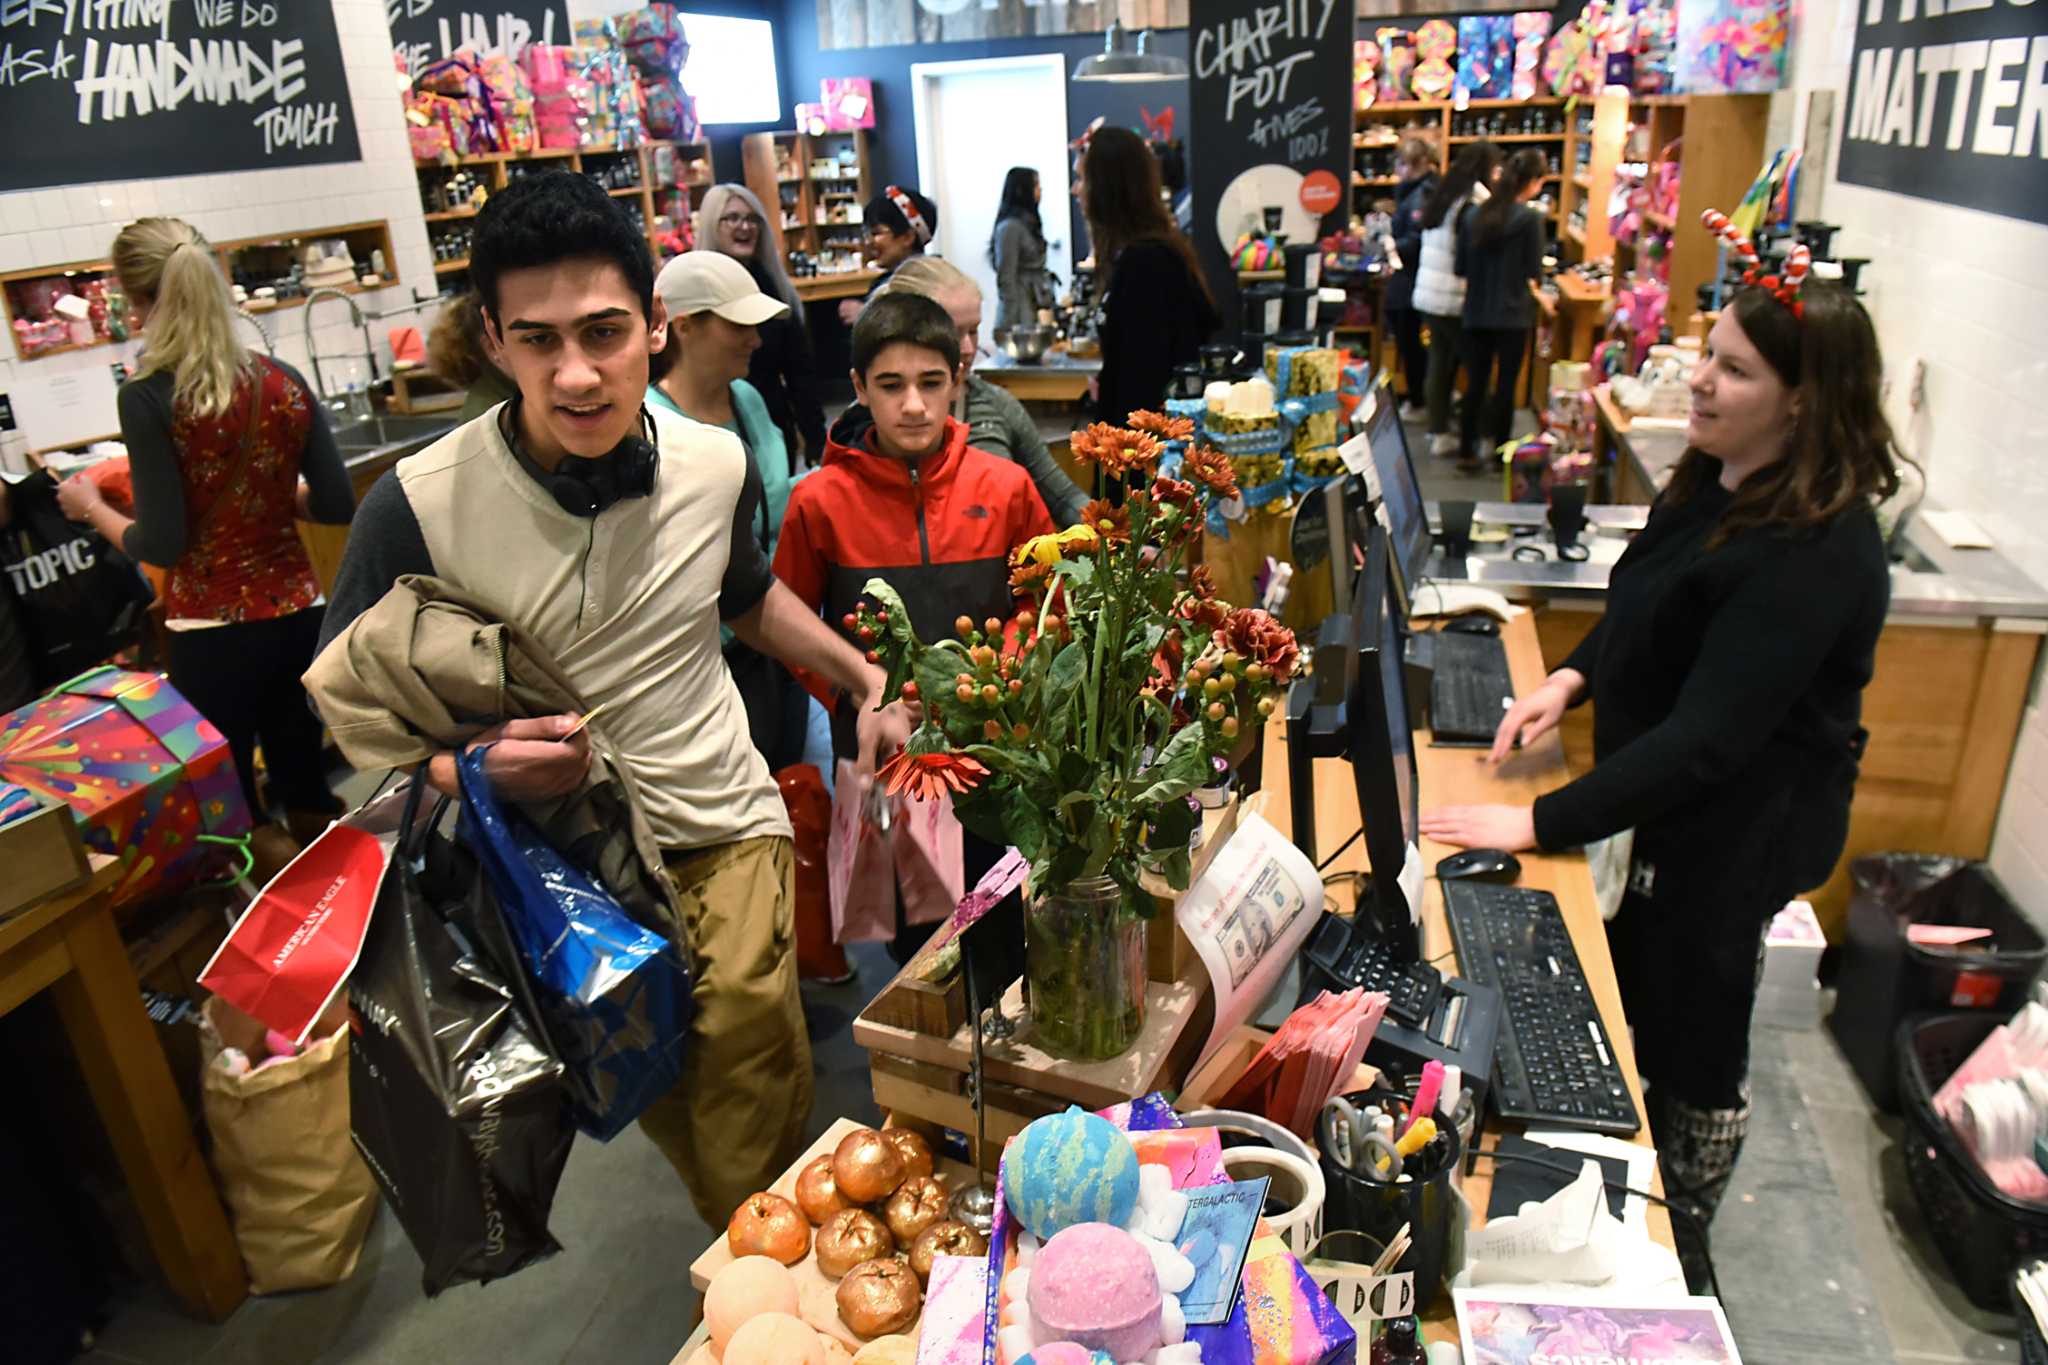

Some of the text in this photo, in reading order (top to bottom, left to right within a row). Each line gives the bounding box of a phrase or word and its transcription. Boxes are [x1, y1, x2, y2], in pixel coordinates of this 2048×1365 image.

[194, 0, 234, 28] WE
[241, 0, 278, 28] DO
[1195, 0, 1335, 78] CHARITY
[74, 37, 306, 125] HANDMADE
[1226, 51, 1315, 121] POT
[1848, 35, 2048, 160] MATTER
[254, 102, 338, 154] TOUCH
[4, 537, 95, 595] TOPIC
[272, 908, 321, 968] AMERICAN
[315, 874, 347, 912] EAGLE
